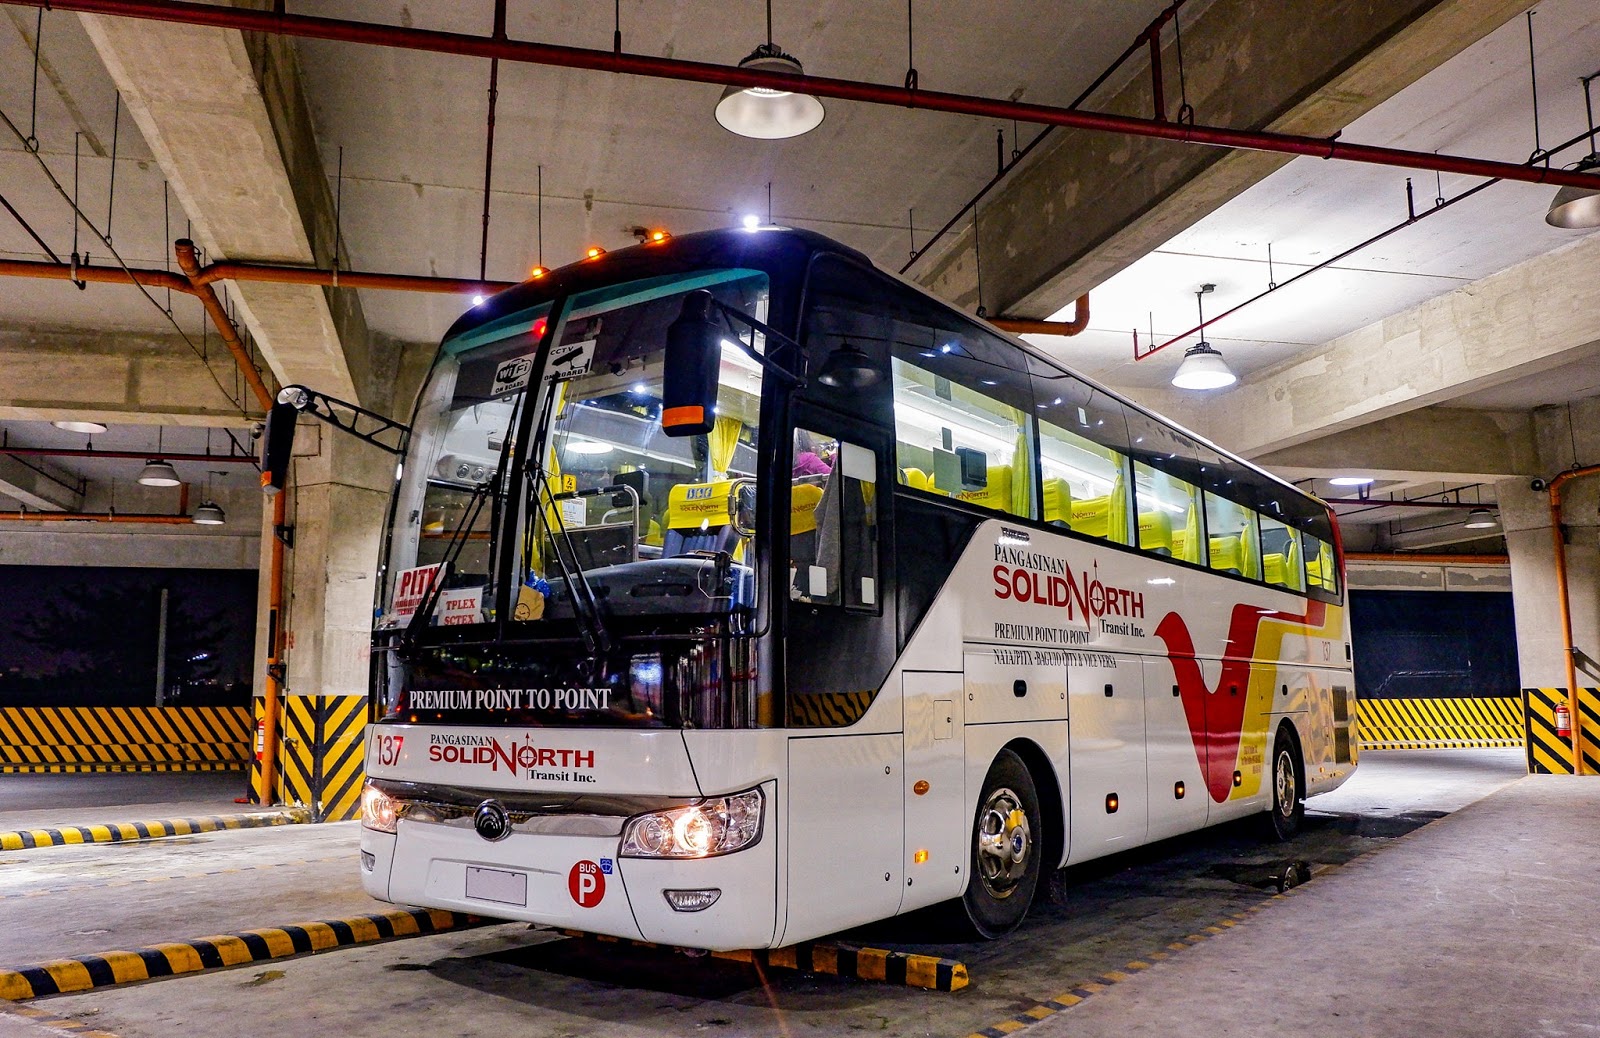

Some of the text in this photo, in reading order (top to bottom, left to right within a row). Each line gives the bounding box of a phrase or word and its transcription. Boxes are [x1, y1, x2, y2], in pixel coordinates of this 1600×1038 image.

[550, 346, 574, 356] CCTV
[504, 380, 525, 391] BOARD
[994, 544, 1066, 575] PANGASINAN
[446, 598, 476, 611] TPLEX
[444, 614, 475, 626] SCTEX
[994, 623, 1090, 645] PREMIUM POINT TO POINT
[1100, 619, 1145, 638] Transit Inc.
[993, 649, 1033, 665] NAIA/PITX
[409, 688, 612, 709] PREMIUM POINT TO POINT
[430, 734, 493, 746] PANGASINAN
[377, 734, 404, 766] 137
[529, 769, 596, 783] Transit Inc.
[580, 863, 597, 874] BUS
[580, 873, 597, 904] P
